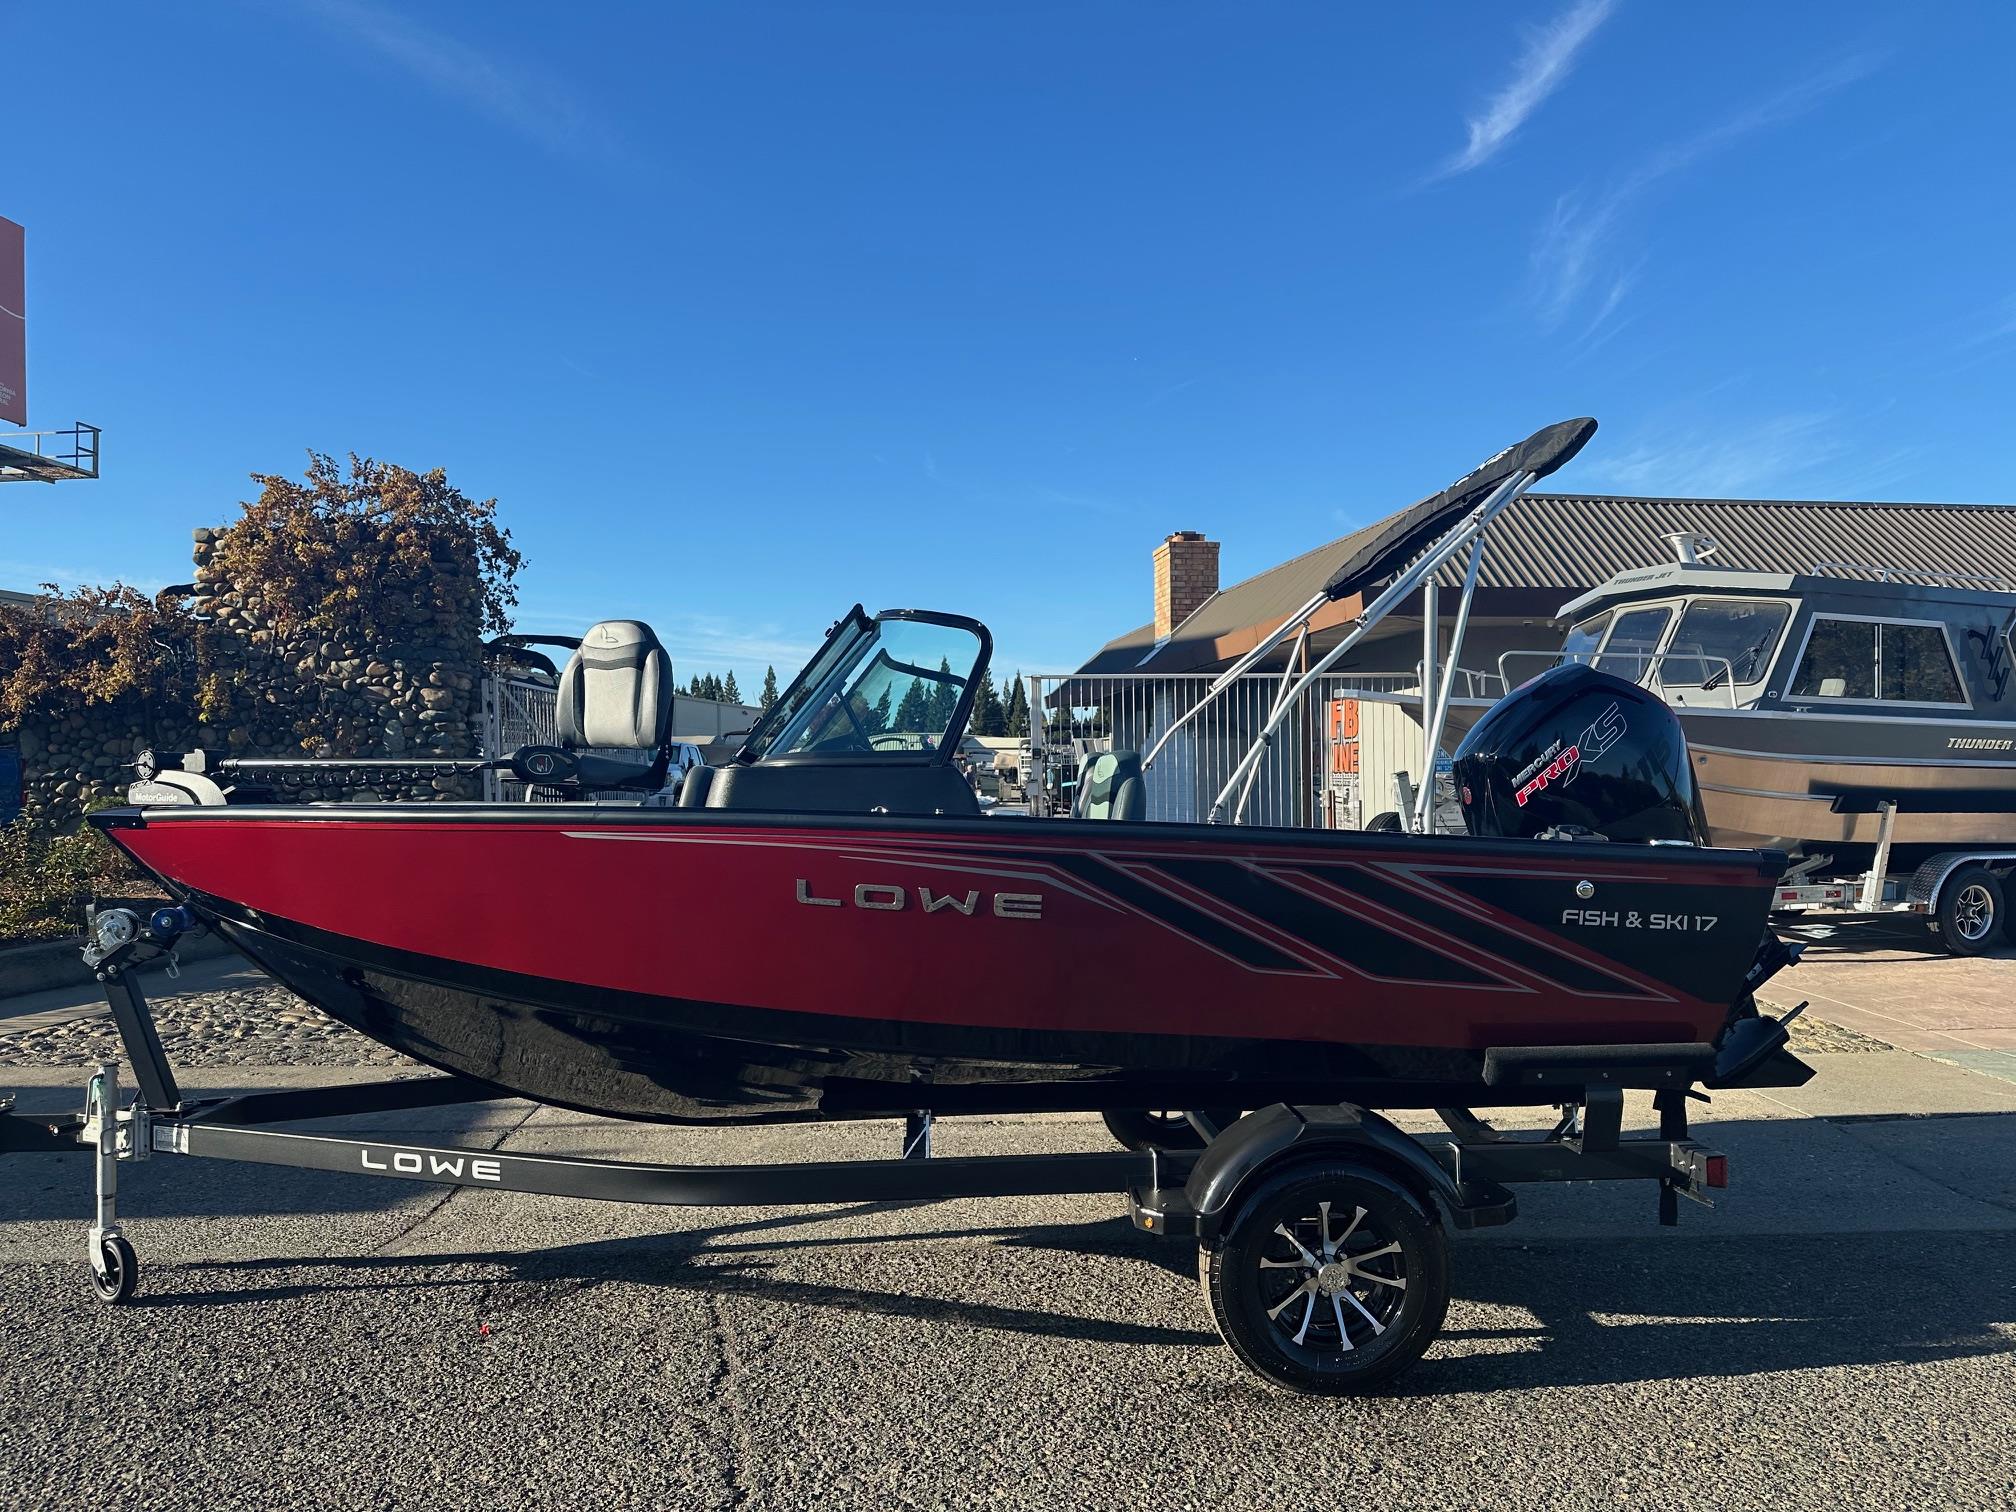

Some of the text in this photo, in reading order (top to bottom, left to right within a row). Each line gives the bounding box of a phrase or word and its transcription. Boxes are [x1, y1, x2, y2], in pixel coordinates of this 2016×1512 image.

[1613, 571, 1675, 585] THUNDER JET
[1947, 737, 2014, 750] THUNDER
[1511, 738, 1561, 788] MERCURY
[135, 792, 178, 803] MotorGuide
[796, 878, 1043, 920] LOWE
[1561, 909, 1719, 932] FISH & SKI 17
[361, 1149, 501, 1182] LOWE
